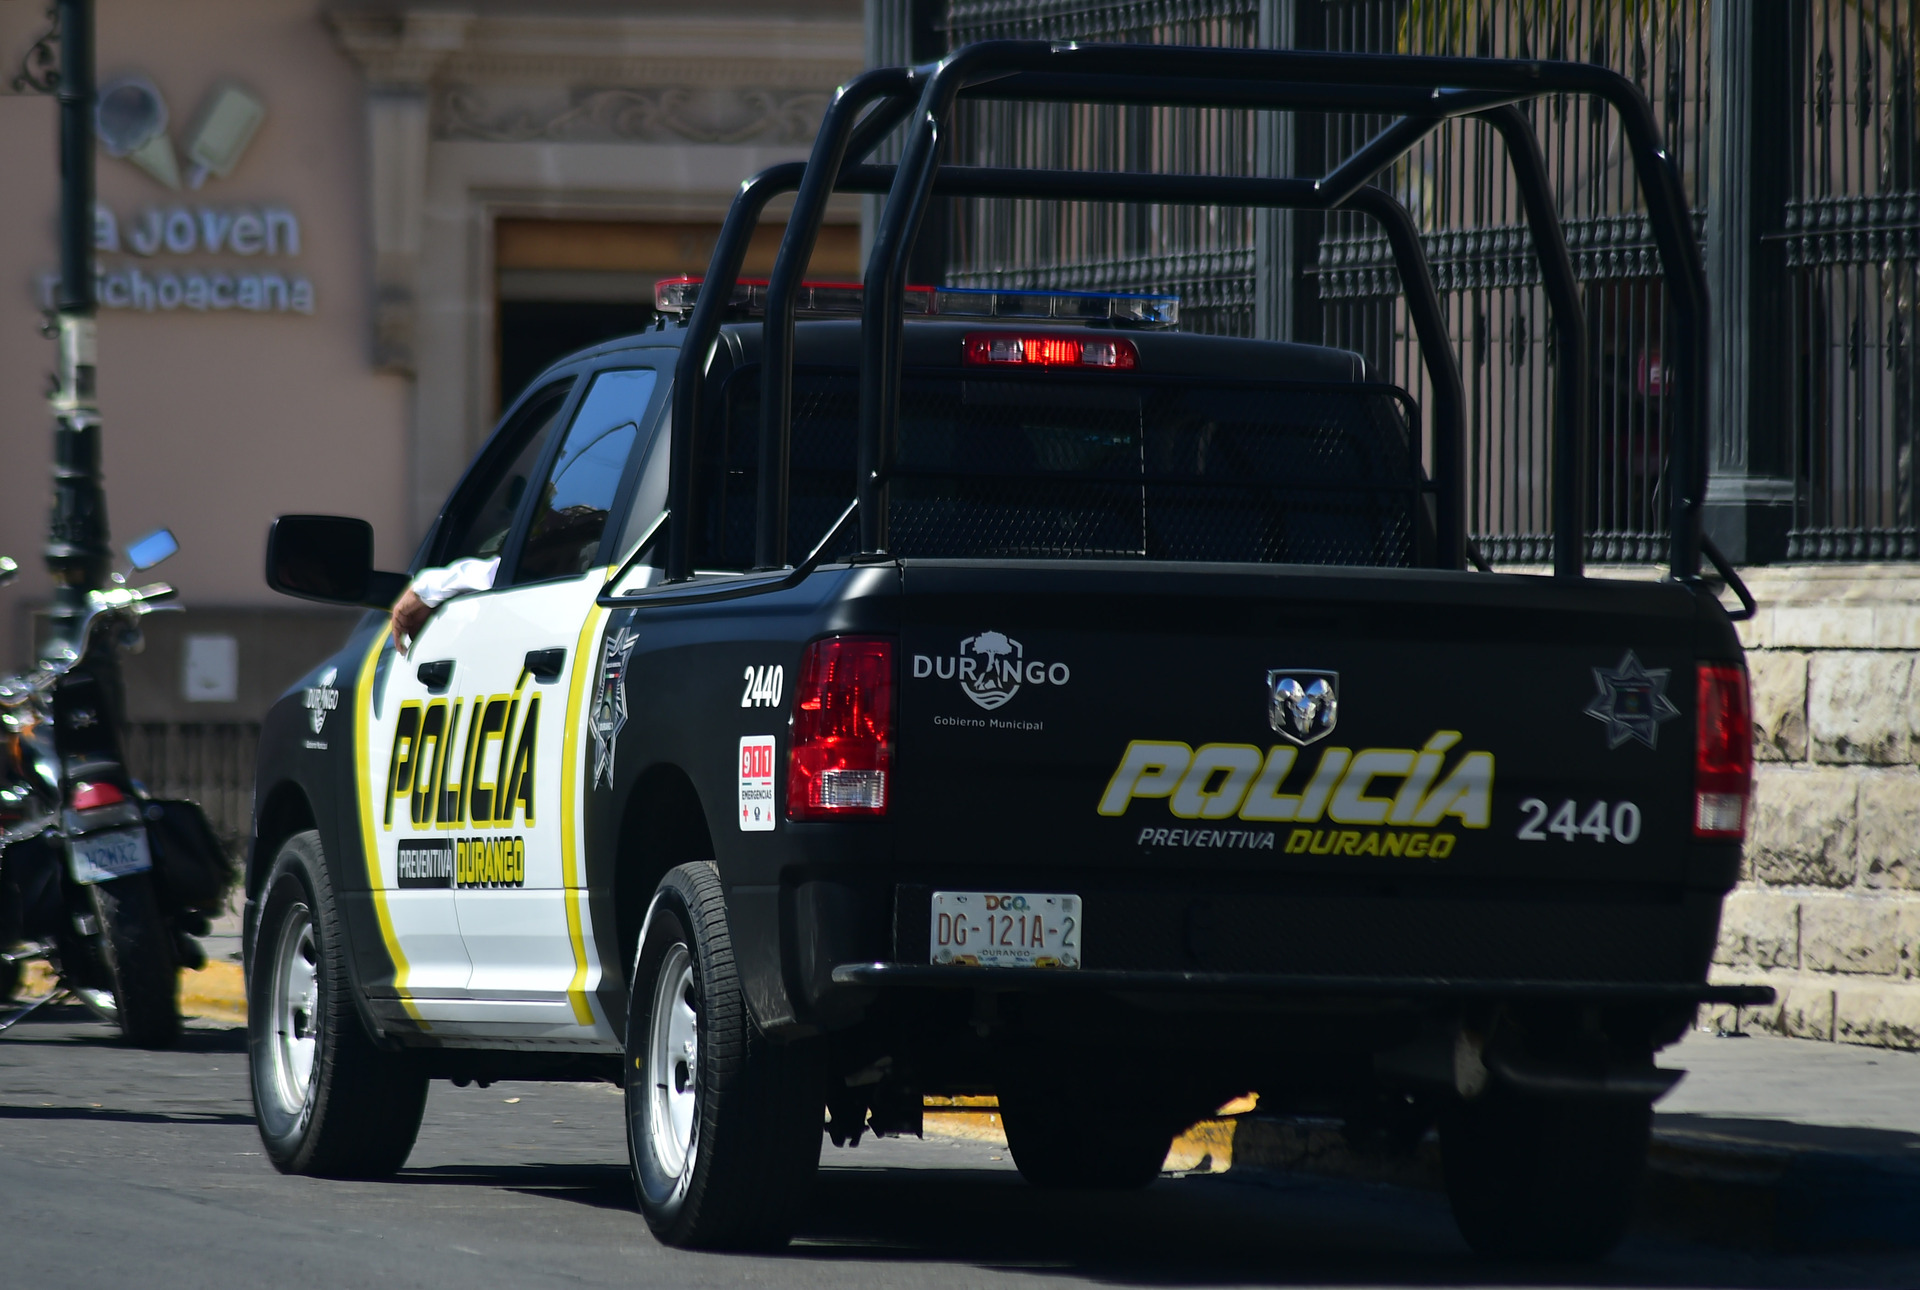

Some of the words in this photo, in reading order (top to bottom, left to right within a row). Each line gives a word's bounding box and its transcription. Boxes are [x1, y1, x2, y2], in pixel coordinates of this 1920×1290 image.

[130, 207, 300, 257] Joven
[741, 664, 784, 708] 2440
[934, 716, 986, 728] Gobierno
[990, 719, 1043, 731] Municipal
[384, 664, 542, 832] POLICÍA
[743, 749, 771, 776] 911
[742, 790, 772, 801] EMERGENCIAS
[1097, 730, 1496, 829] POLICÍA
[1137, 828, 1275, 849] PREVENTIVA
[1284, 829, 1456, 859] DURANGO
[1517, 798, 1641, 845] 2440
[400, 848, 453, 880] PREVENTIVA
[457, 836, 525, 888] DURANGO
[938, 913, 1075, 948] DG-121A-2
